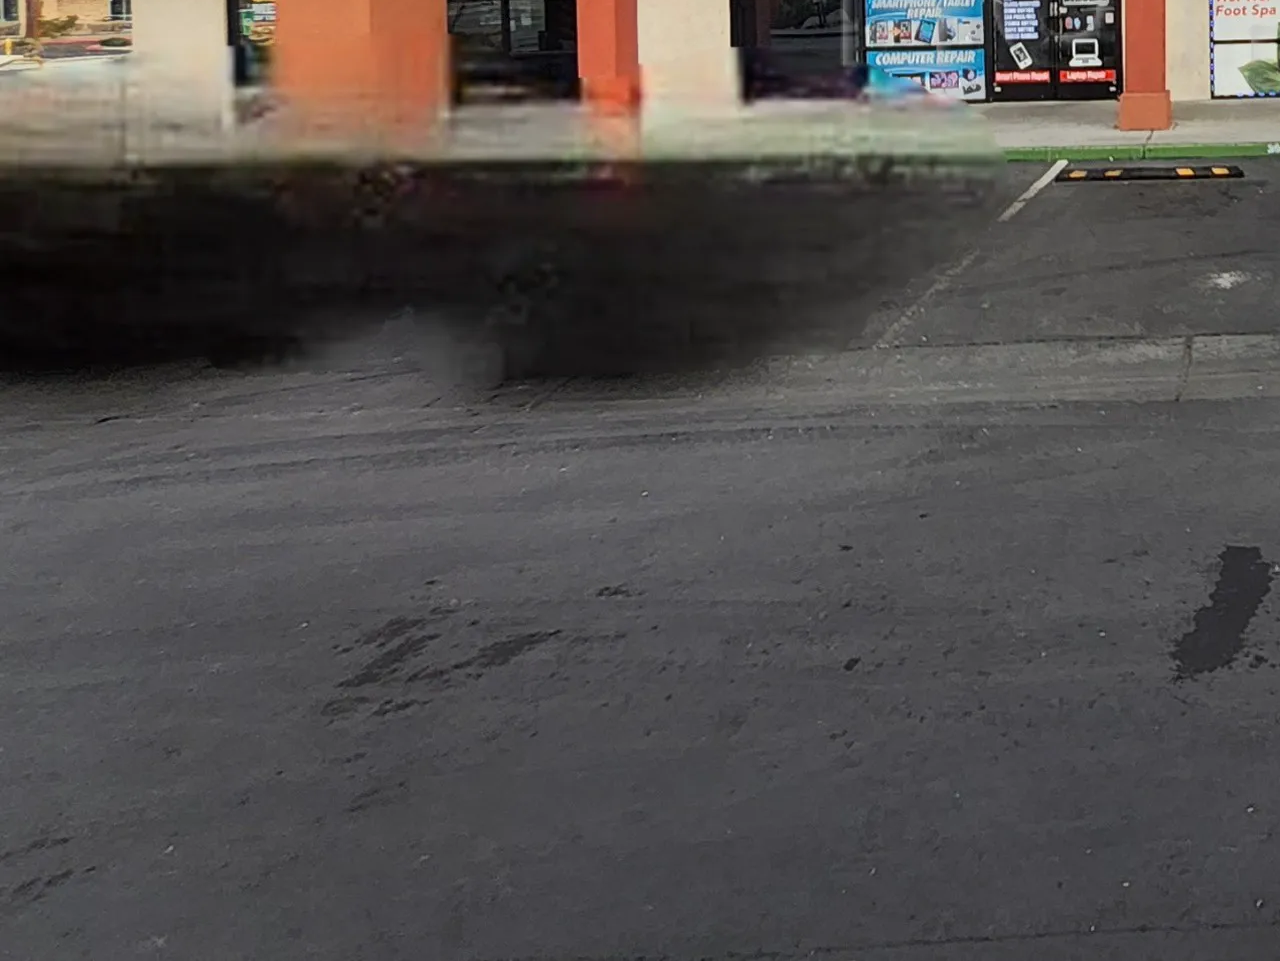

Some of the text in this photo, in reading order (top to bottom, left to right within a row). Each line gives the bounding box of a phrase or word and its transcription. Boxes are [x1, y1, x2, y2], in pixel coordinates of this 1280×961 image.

[907, 8, 943, 19] REPAIR
[1216, 4, 1277, 18] Foot Spa
[876, 50, 976, 65] COMPUTER REPAIR
